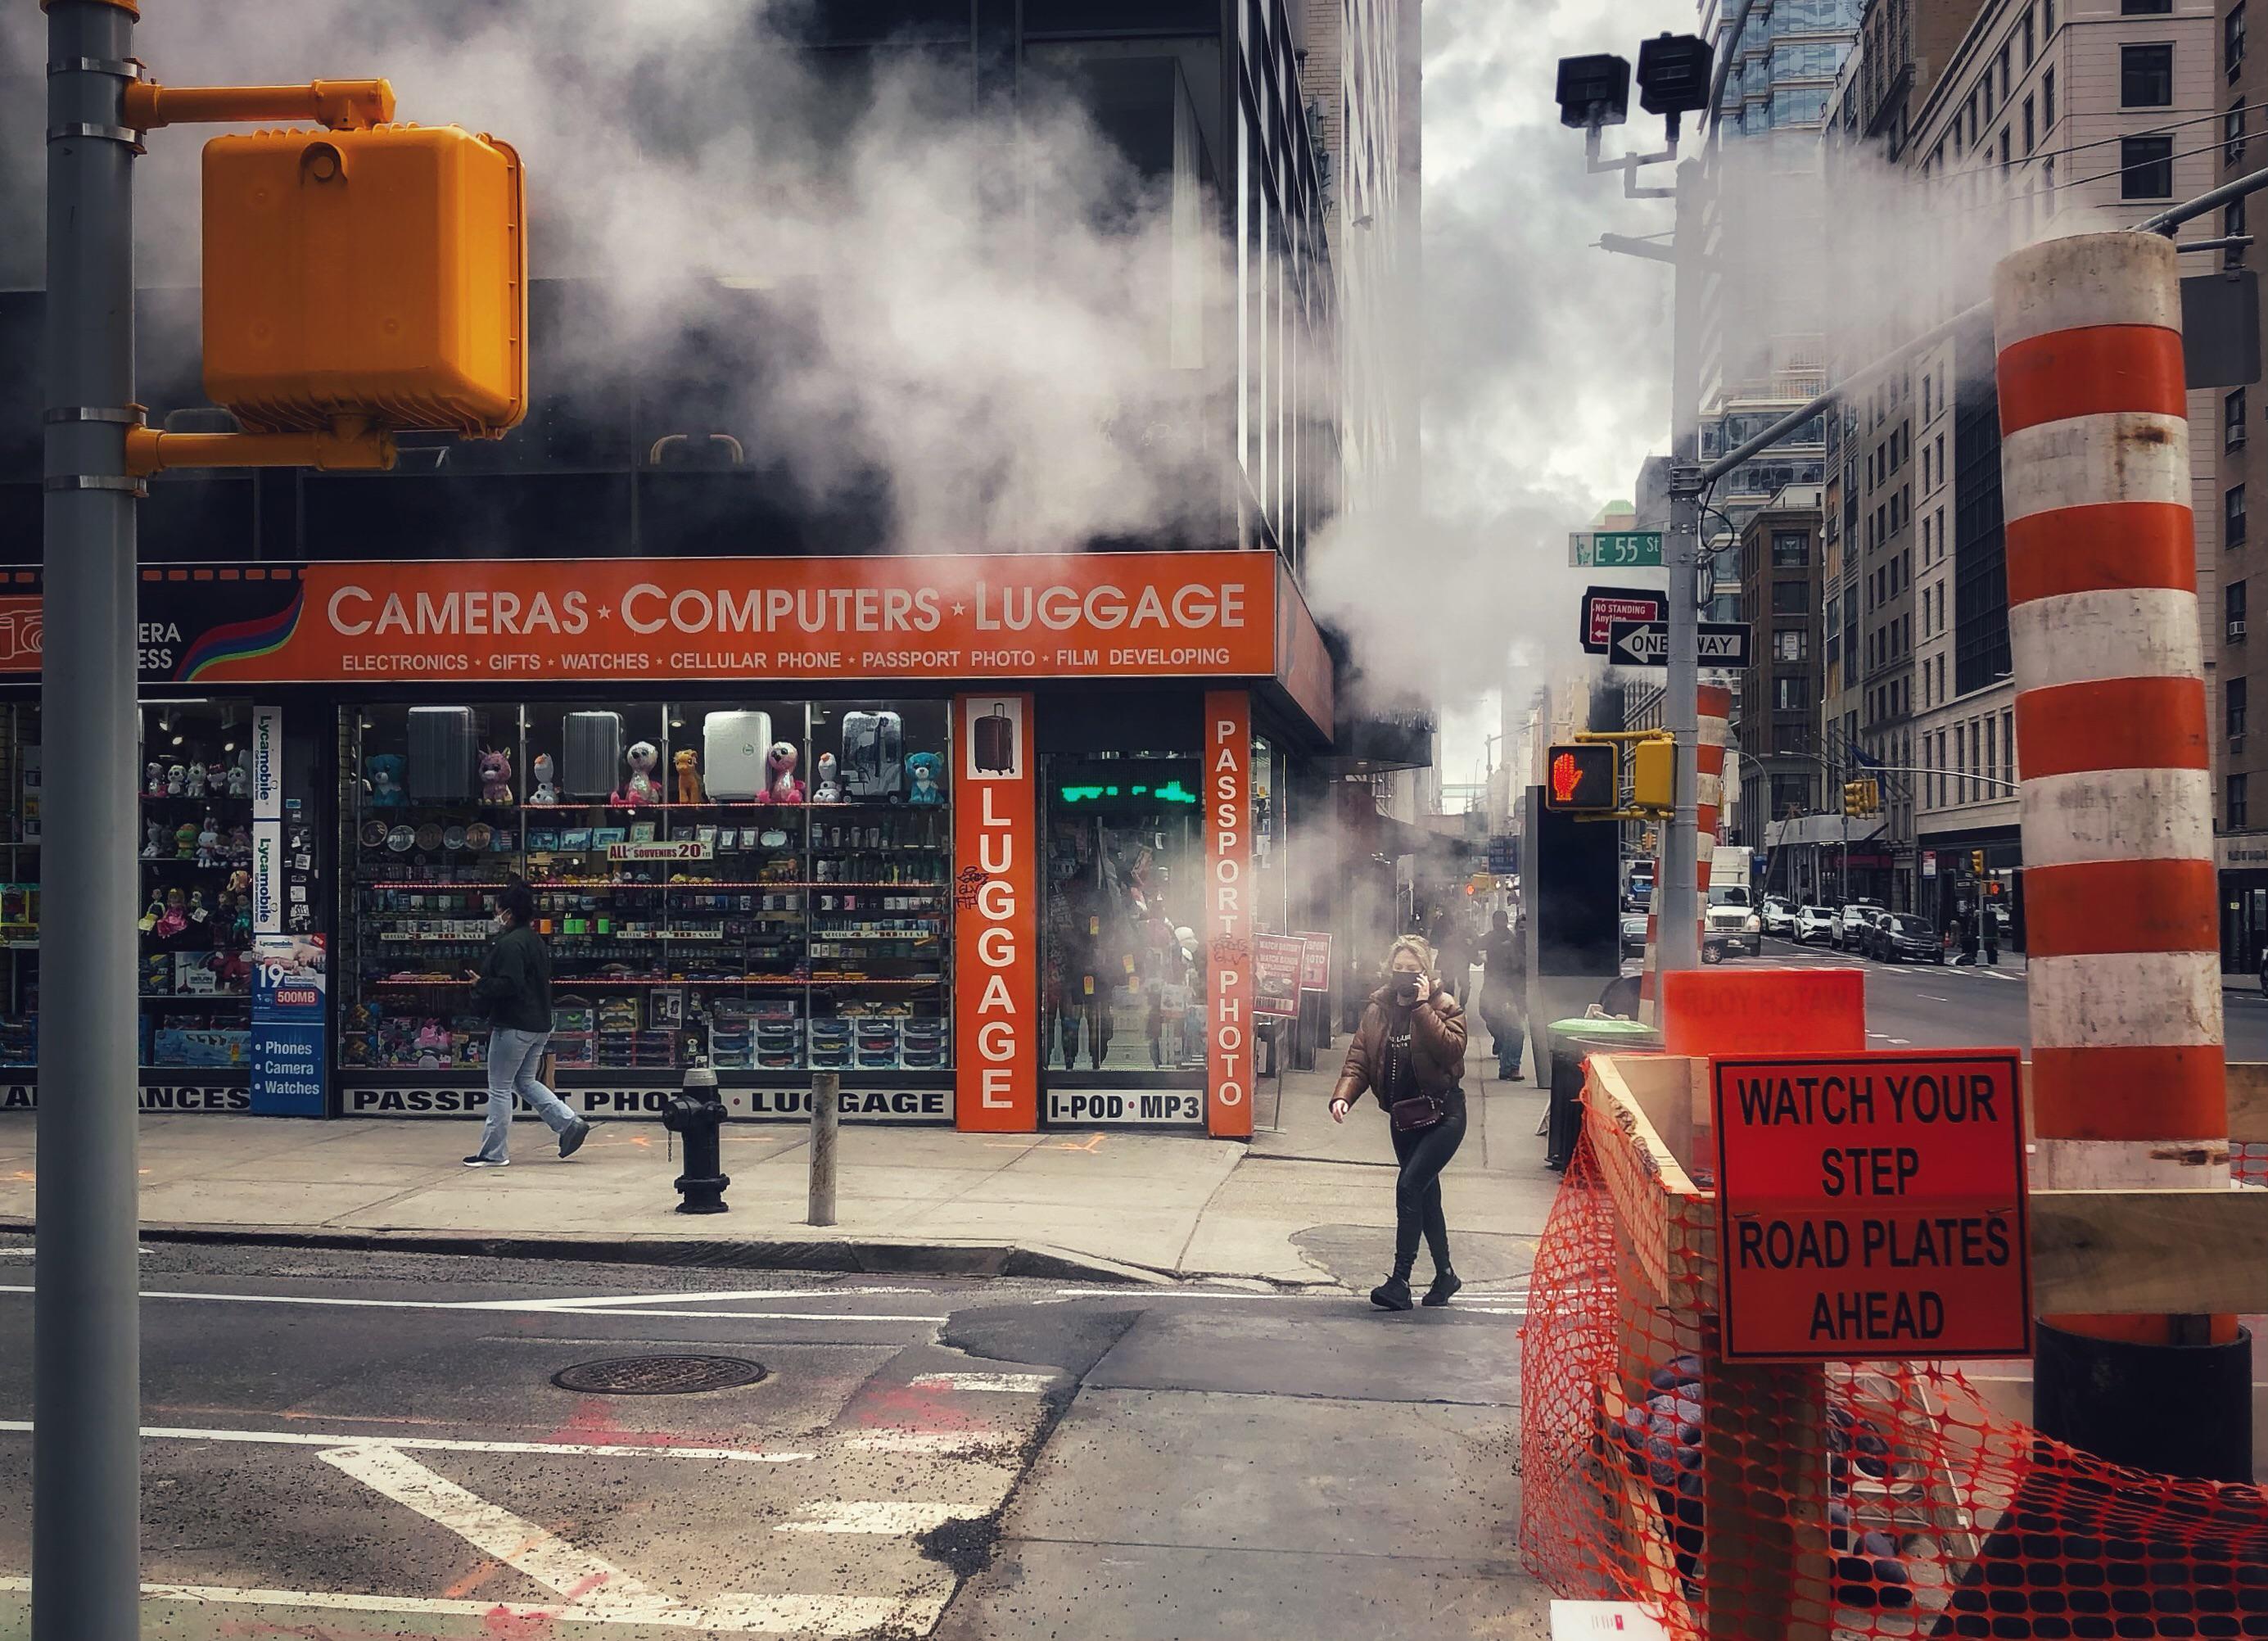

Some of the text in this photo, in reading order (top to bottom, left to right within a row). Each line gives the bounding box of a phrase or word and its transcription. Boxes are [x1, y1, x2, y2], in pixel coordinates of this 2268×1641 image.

[1596, 536, 1660, 563] E 55 St
[328, 581, 1245, 635] CAMERAS COMPUTERS LUGGAGE
[1595, 603, 1646, 615] NO STANDING
[138, 622, 182, 643] ERA
[1632, 635, 1668, 653] ONE
[342, 648, 1230, 671] ELECTRONICS GIFTS WATCHES CELLULAR PHONE PASSPORT PHOTO FILM DEVELOPING
[258, 715, 272, 800] Lycamobile
[1215, 720, 1240, 938] PASSPORT
[610, 844, 628, 859] ALL
[634, 848, 677, 857] SOUVENIRS
[258, 838, 272, 923] Lycamobile
[977, 787, 1016, 1109] LUGGAGE
[278, 991, 315, 1003] 500MB
[265, 1041, 312, 1055] Phones
[1218, 970, 1243, 1107] PHOTO
[265, 1060, 314, 1074] Camera
[264, 1081, 319, 1094] Watches
[1737, 1074, 1998, 1126] WATCH YOUR
[354, 1090, 572, 1111] PASSP
[1051, 1095, 1200, 1119] I-POD MP3
[1822, 1147, 1920, 1197] STEP
[1738, 1217, 2010, 1269] ROAD PLATES
[1809, 1291, 1945, 1340] AHEAD
